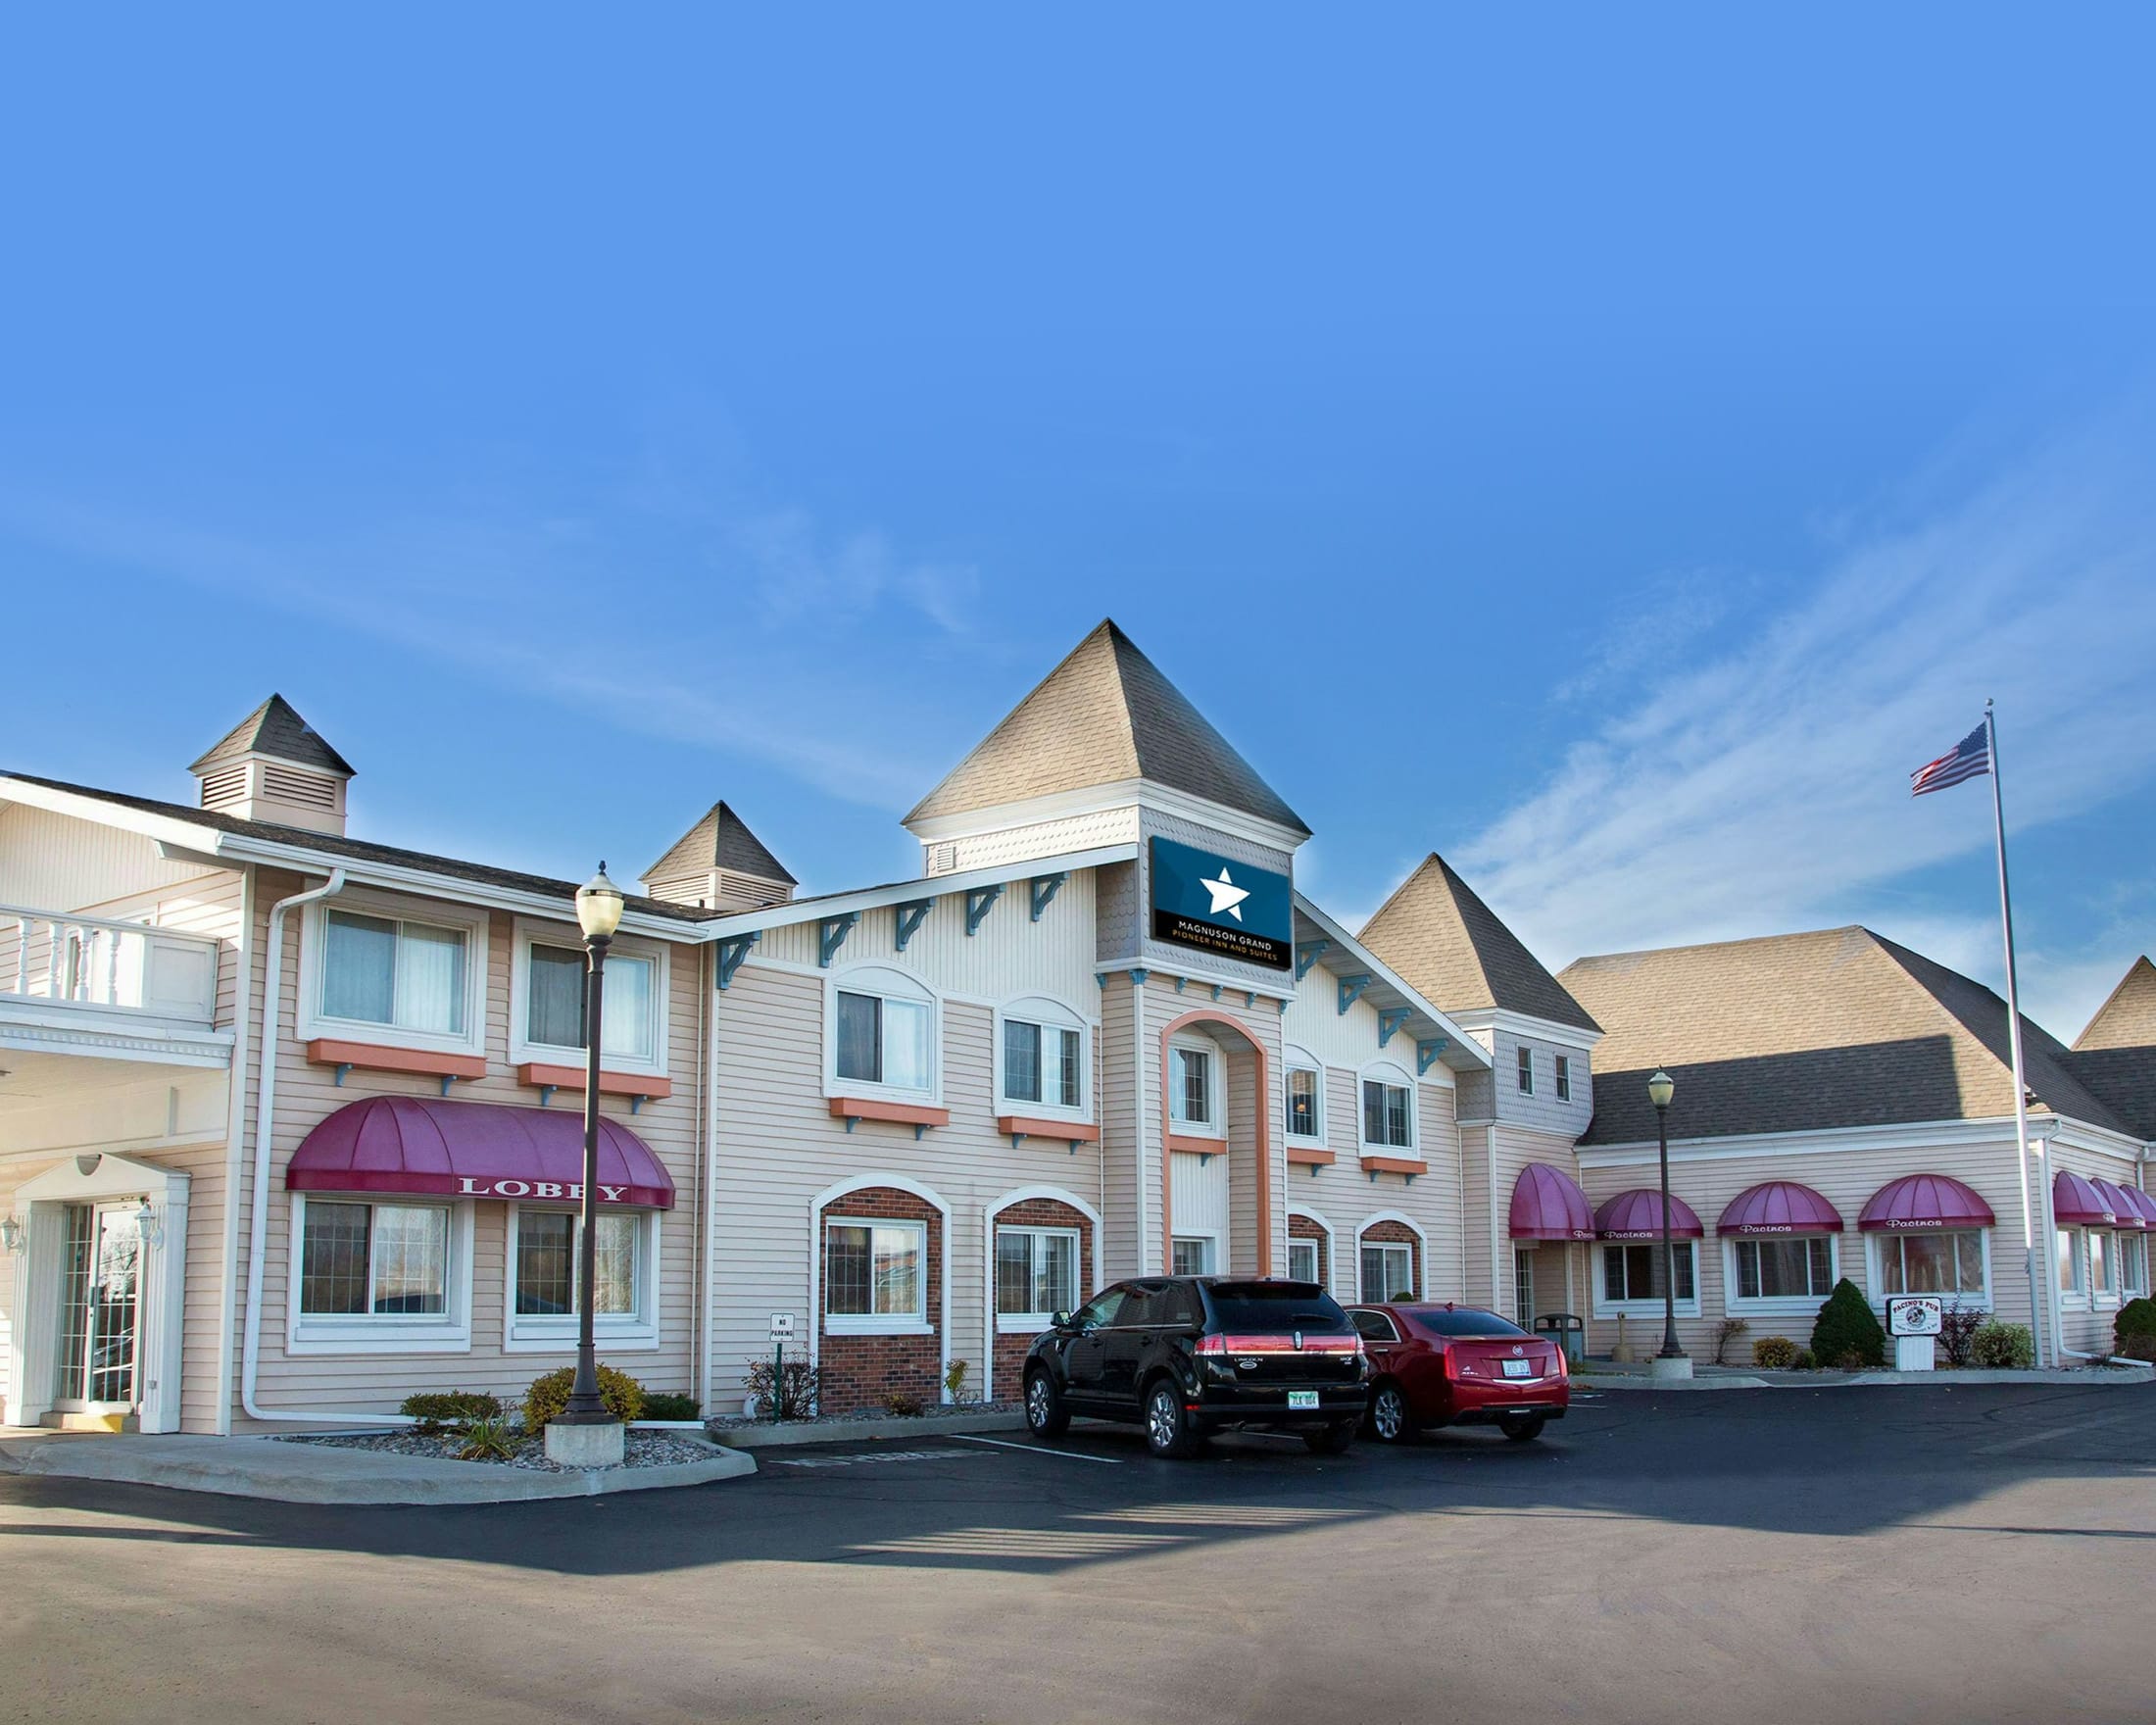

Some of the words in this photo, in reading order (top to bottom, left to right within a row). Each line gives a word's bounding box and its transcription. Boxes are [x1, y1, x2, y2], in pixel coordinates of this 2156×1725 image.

[1172, 929, 1209, 945] PIONEER
[1212, 940, 1228, 949] INN
[1230, 944, 1248, 954] AND
[1250, 949, 1278, 961] SUITES
[1178, 920, 1237, 942] MAGNUSON
[1239, 936, 1272, 951] GRAND
[1925, 1301, 1939, 1312] PUB
